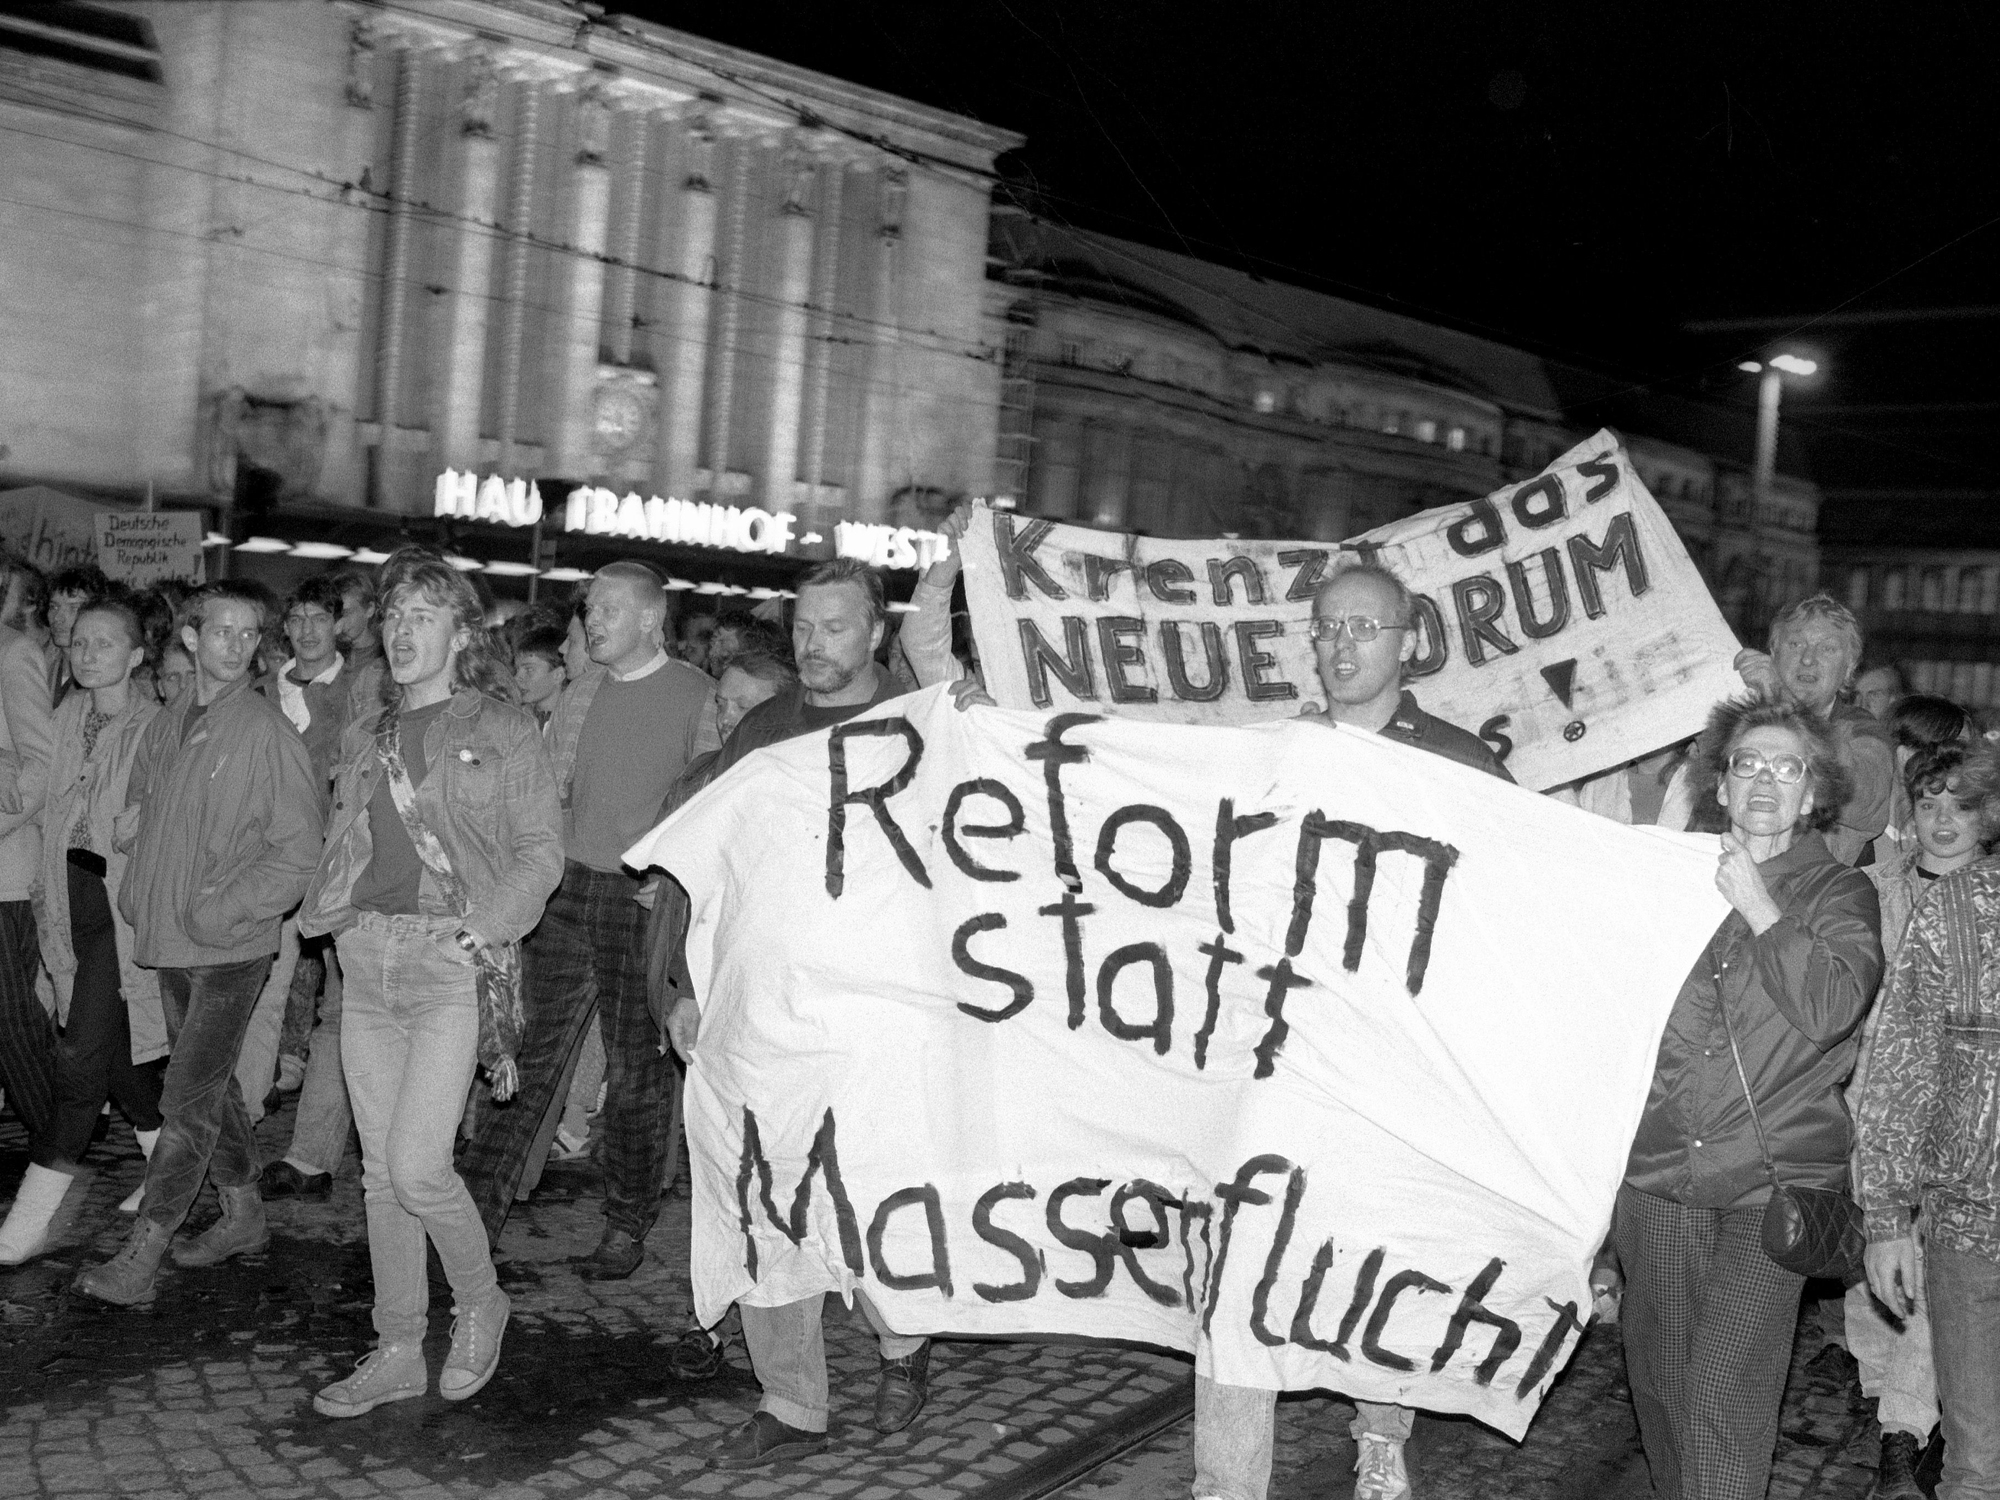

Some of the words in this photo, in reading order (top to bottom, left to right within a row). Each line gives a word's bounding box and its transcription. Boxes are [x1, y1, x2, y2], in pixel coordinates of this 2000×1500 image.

[108, 515, 169, 531] Deutsche
[117, 549, 168, 569] Republik
[1447, 451, 1620, 559] das
[1017, 615, 1298, 708] NEUE
[1403, 512, 1649, 679] ORUM
[825, 713, 1460, 996] Reform
[951, 893, 1313, 1080] statt
[737, 1106, 1584, 1400] Massenflucht
